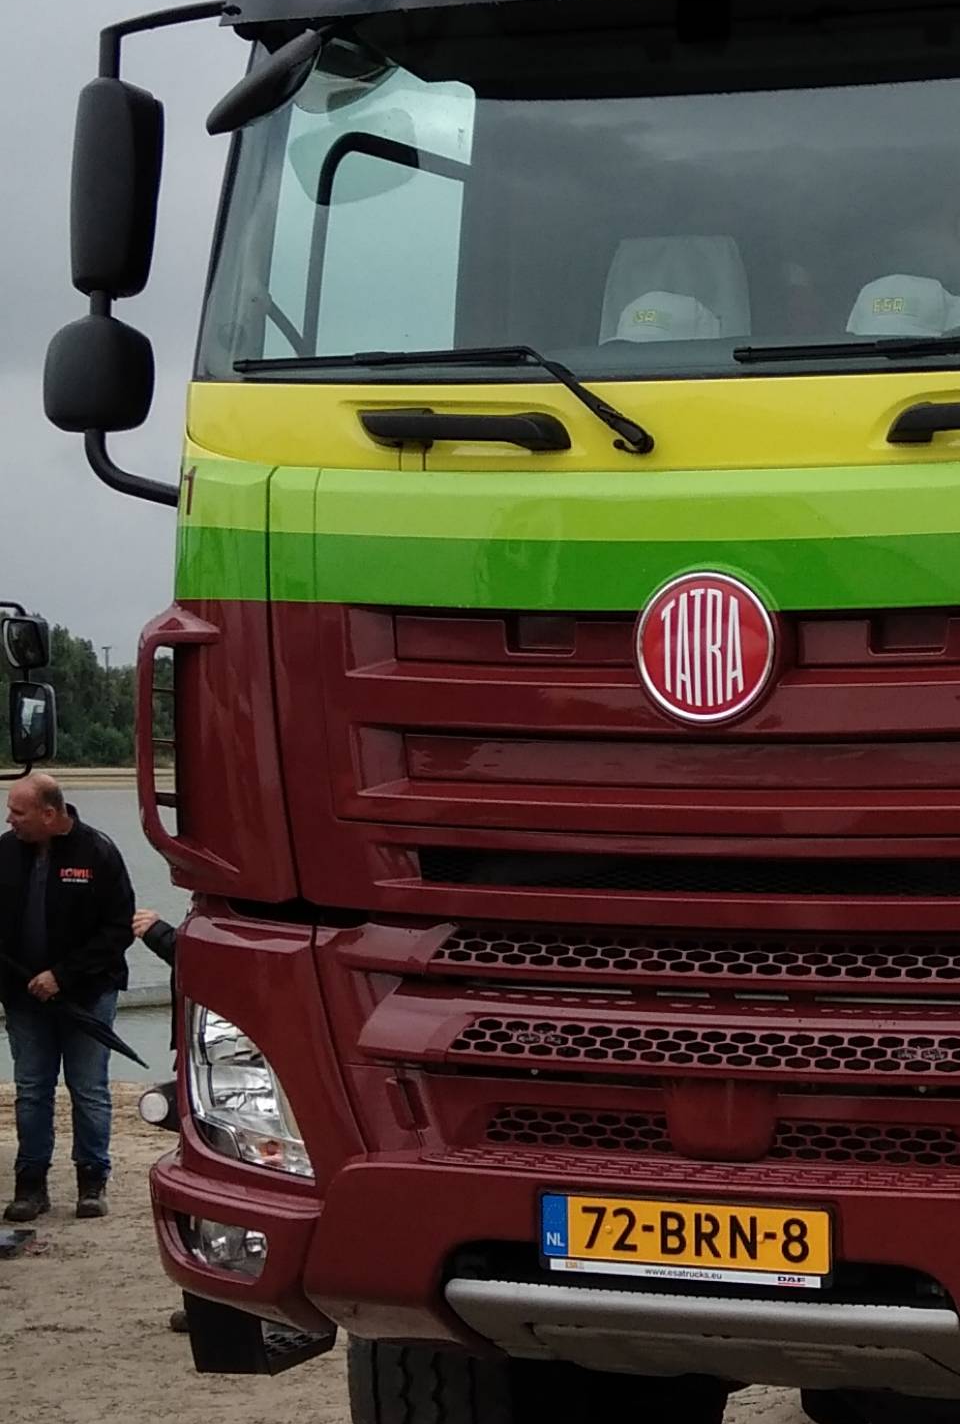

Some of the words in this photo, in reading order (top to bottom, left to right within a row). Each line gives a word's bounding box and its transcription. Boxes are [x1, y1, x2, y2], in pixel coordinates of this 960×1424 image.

[661, 588, 744, 707] TATRA
[546, 1232, 565, 1247] NL
[581, 1205, 810, 1264] 72-BRN-8
[644, 1267, 723, 1280] www.esatrucks.eu
